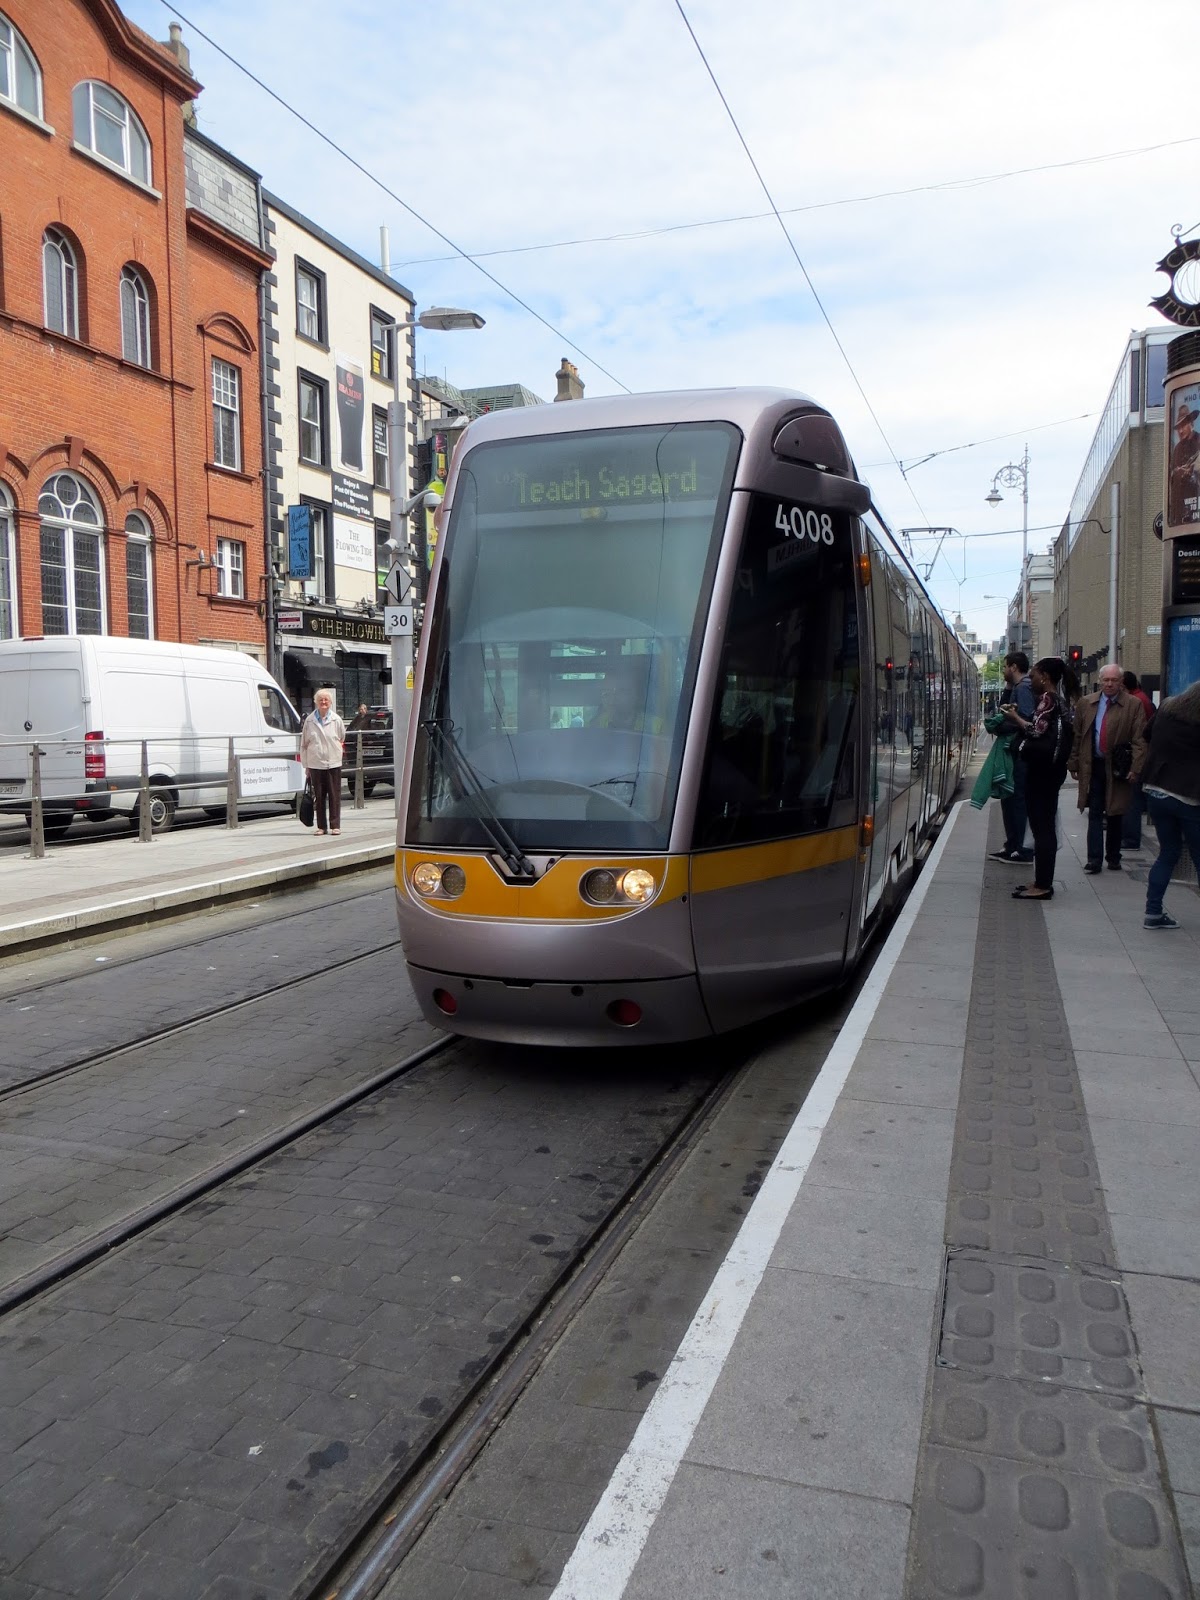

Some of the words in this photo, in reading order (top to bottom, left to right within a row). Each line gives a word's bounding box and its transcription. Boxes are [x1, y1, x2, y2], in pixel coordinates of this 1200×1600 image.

[1161, 296, 1200, 326] TRA
[343, 478, 356, 490] Enjoy
[514, 468, 591, 504] Teach
[598, 459, 698, 498] Sagard
[334, 484, 345, 494] Pint
[350, 489, 369, 502] Beamish
[333, 498, 343, 508] The
[360, 506, 371, 516] Tide
[775, 503, 835, 546] 4008
[348, 529, 360, 542] THE
[335, 538, 360, 554] FLOWING
[360, 544, 373, 557] TIDE
[318, 618, 343, 637] THE
[390, 614, 408, 627] 30
[1178, 624, 1190, 632] WHO
[243, 767, 256, 775] Sráid
[262, 765, 291, 773] Mainistreach
[243, 777, 258, 785] Abbey
[258, 776, 273, 784] Street
